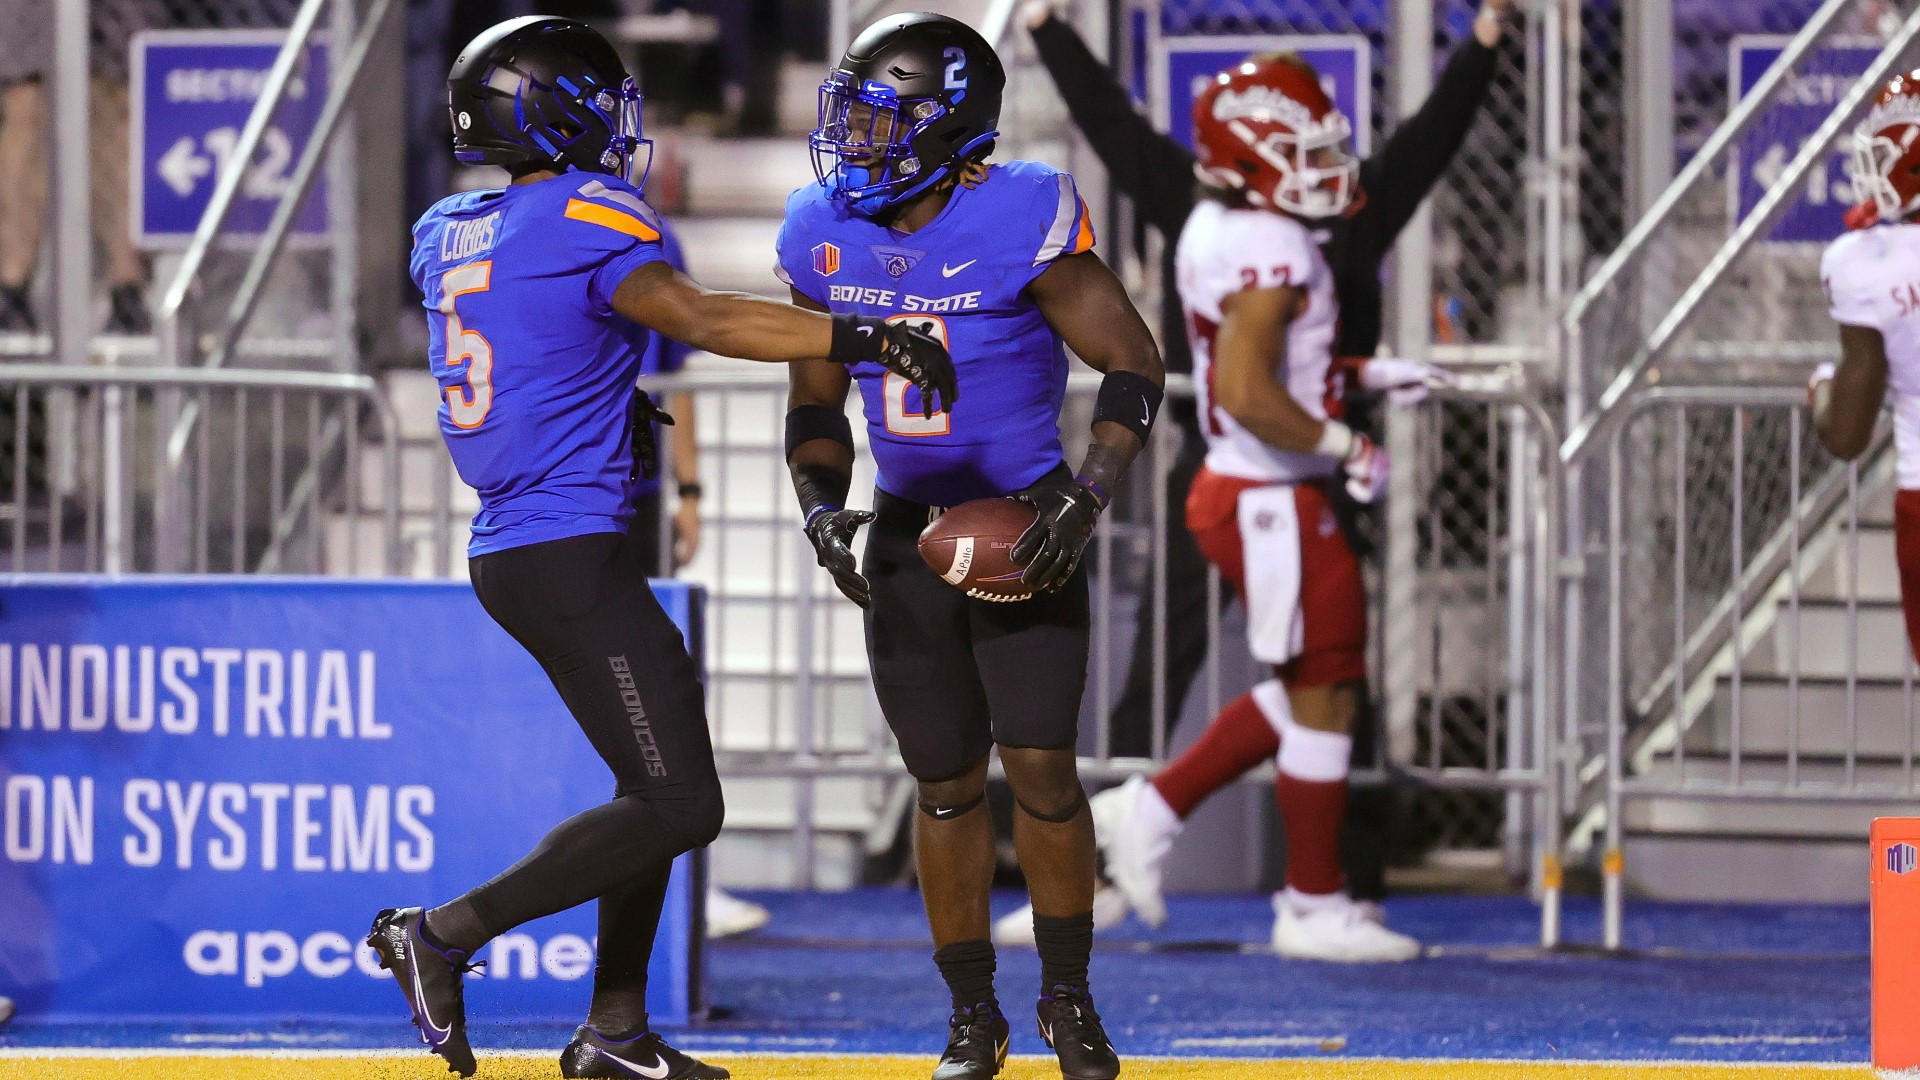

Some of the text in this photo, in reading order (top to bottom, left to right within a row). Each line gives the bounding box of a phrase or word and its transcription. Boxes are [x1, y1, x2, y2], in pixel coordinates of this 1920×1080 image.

[165, 68, 306, 101] SECTI
[943, 46, 968, 91] 2
[441, 211, 501, 263] COBBS
[440, 260, 494, 430] 5
[829, 285, 982, 312] BOISE STATE
[883, 313, 950, 437] 2
[0, 643, 391, 739] INDUSTRIAL
[608, 654, 667, 777] BRONCOS
[4, 774, 436, 873] ON SYSTEMS
